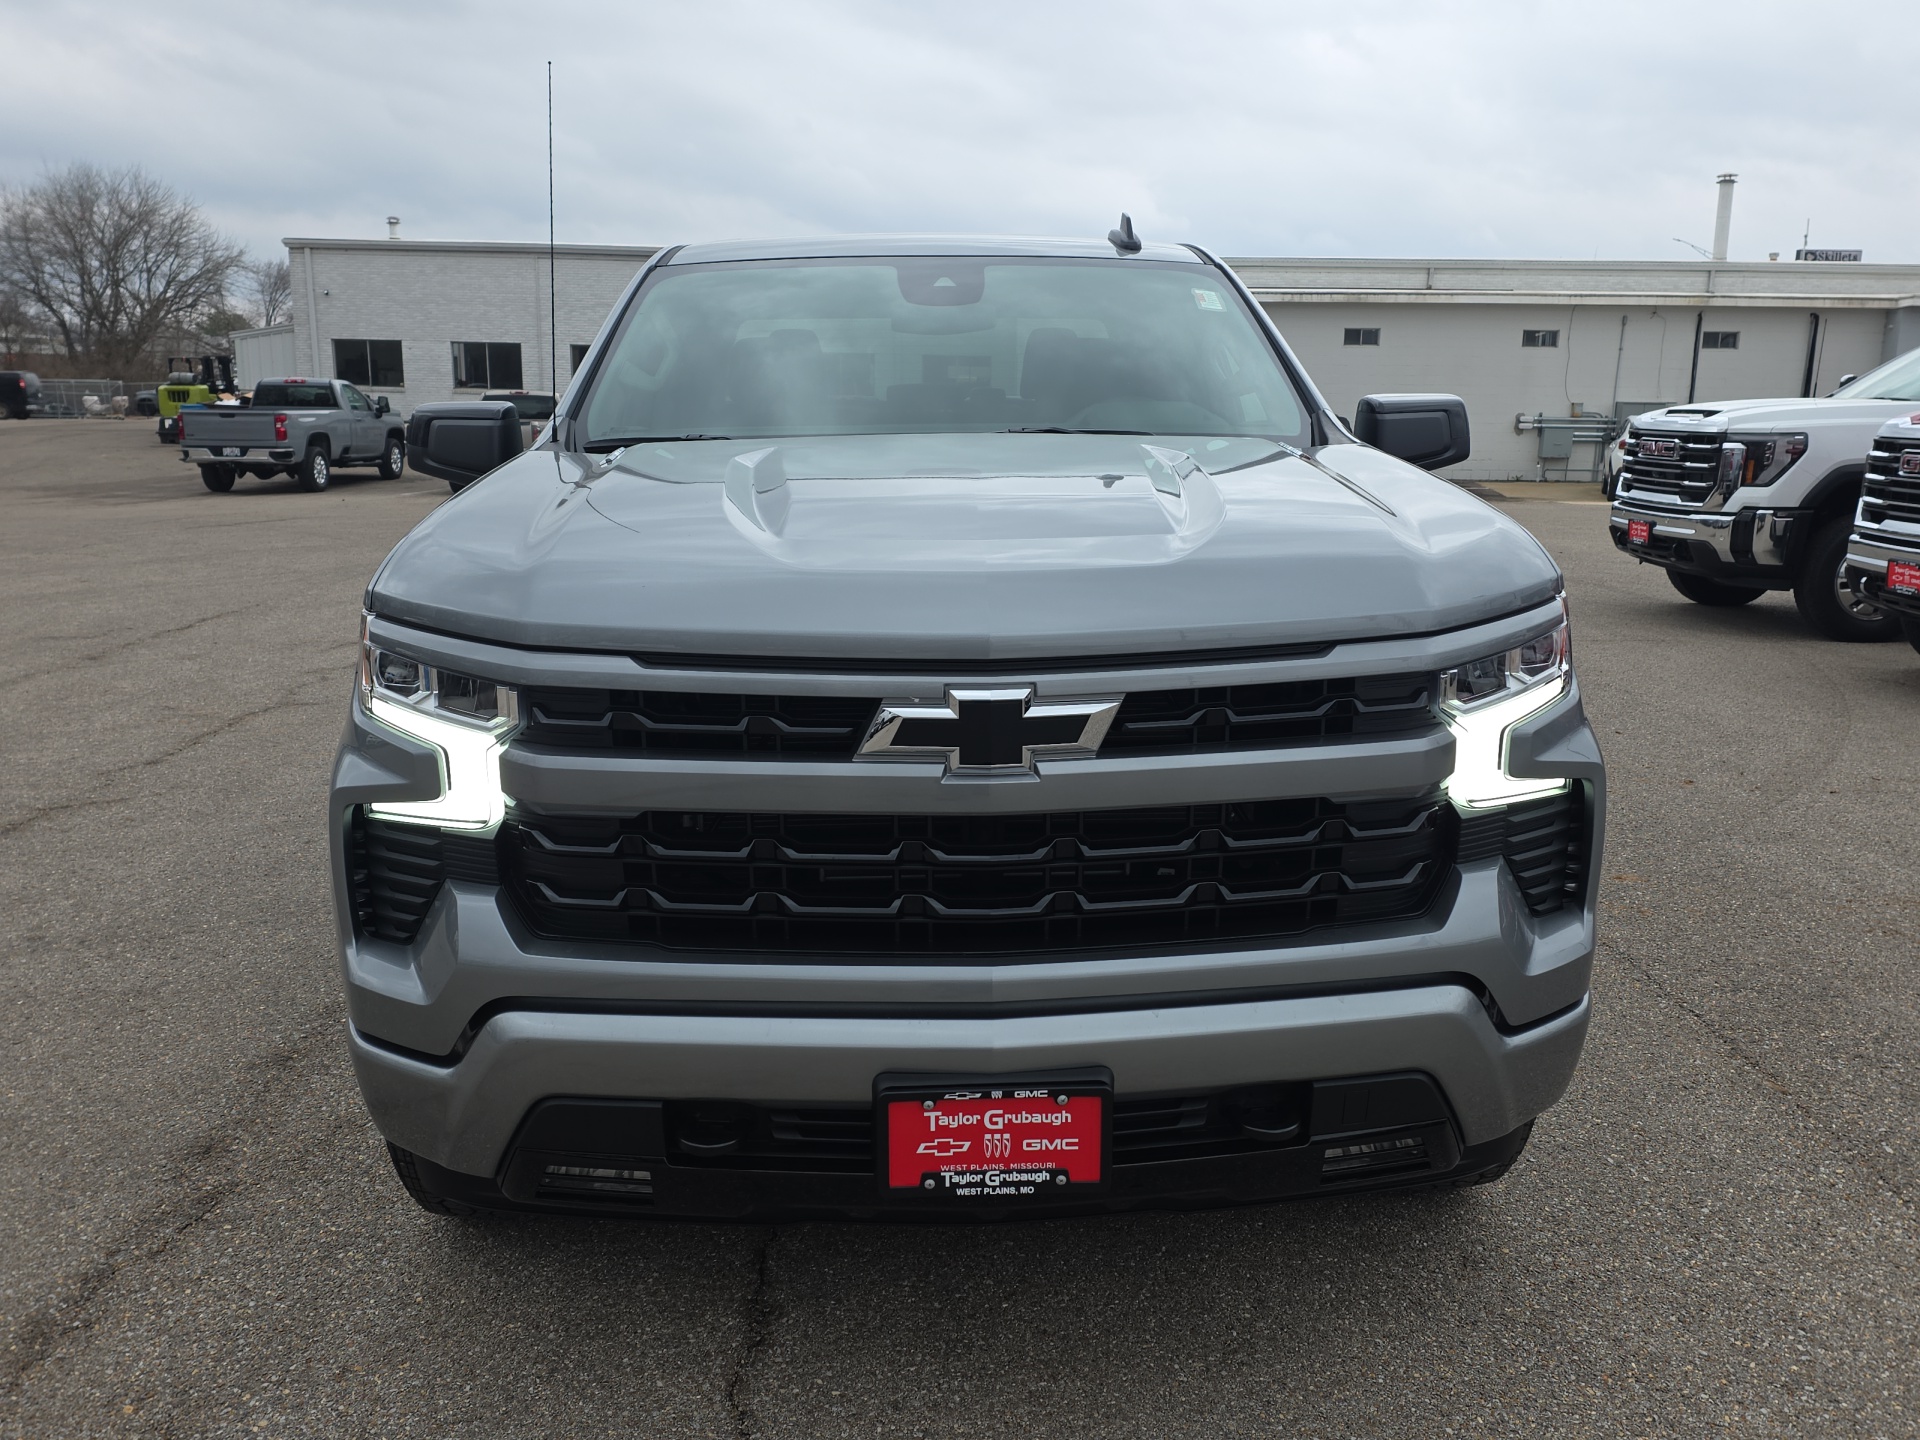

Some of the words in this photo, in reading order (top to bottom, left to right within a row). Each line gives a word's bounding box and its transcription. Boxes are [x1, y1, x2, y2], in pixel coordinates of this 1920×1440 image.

[1639, 441, 1675, 457] GMC
[1014, 1090, 1048, 1098] GMC
[924, 1111, 981, 1131] Taylor
[983, 1109, 1072, 1130] Grubaugh
[1022, 1138, 1079, 1151] GMC
[940, 1164, 968, 1172] WEST
[1010, 1162, 1056, 1170] MISSOURI
[940, 1172, 983, 1188] Taylor
[984, 1170, 1050, 1186] Grubaugh
[956, 1188, 982, 1196] WEST
[983, 1186, 1018, 1196] PLAINS,
[1020, 1186, 1035, 1194] MO
